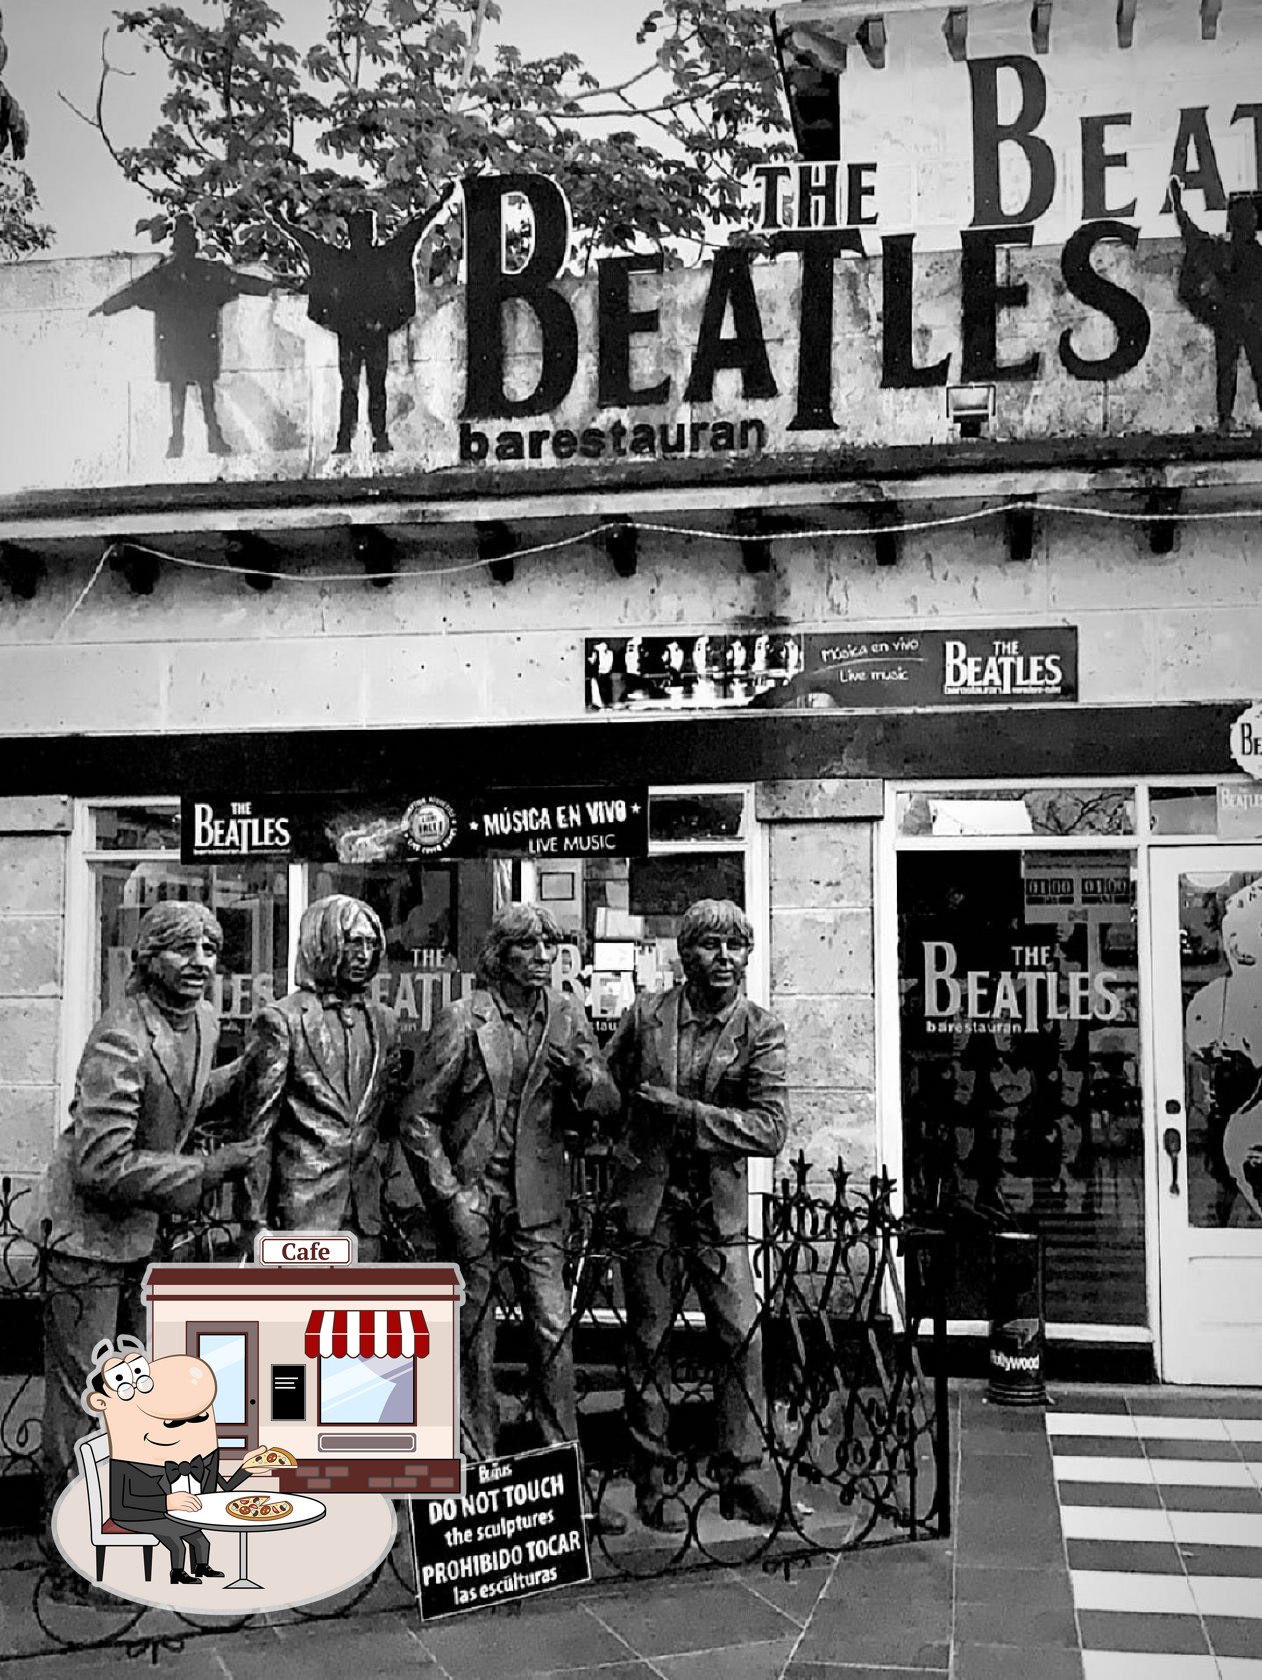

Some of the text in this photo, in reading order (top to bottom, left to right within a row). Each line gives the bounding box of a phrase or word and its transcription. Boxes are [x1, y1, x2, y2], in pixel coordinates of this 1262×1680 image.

[753, 161, 877, 227] THE
[459, 174, 1151, 430] BEATLES
[459, 418, 766, 461] barestauran
[871, 642, 890, 653] en
[945, 640, 1063, 694] BEATLES
[994, 641, 1019, 656] THE
[839, 666, 910, 683] Live music
[230, 801, 252, 815] THE
[483, 806, 552, 837] MÚSICA
[556, 804, 582, 829] EN
[585, 799, 627, 825] VIVO
[194, 802, 291, 854] BEATLES
[528, 833, 617, 854] LIVE MUSIC
[410, 948, 446, 968] THE
[1011, 946, 1051, 967] THE
[922, 940, 1121, 1034] BEATLES
[428, 1498, 458, 1525] DO
[461, 1489, 501, 1518] NOT
[503, 1473, 565, 1508] TOUCH
[444, 1508, 555, 1548] the sculptures
[421, 1530, 581, 1587] PROHIBIDO TOCAR
[453, 1566, 558, 1605] las esculturas
